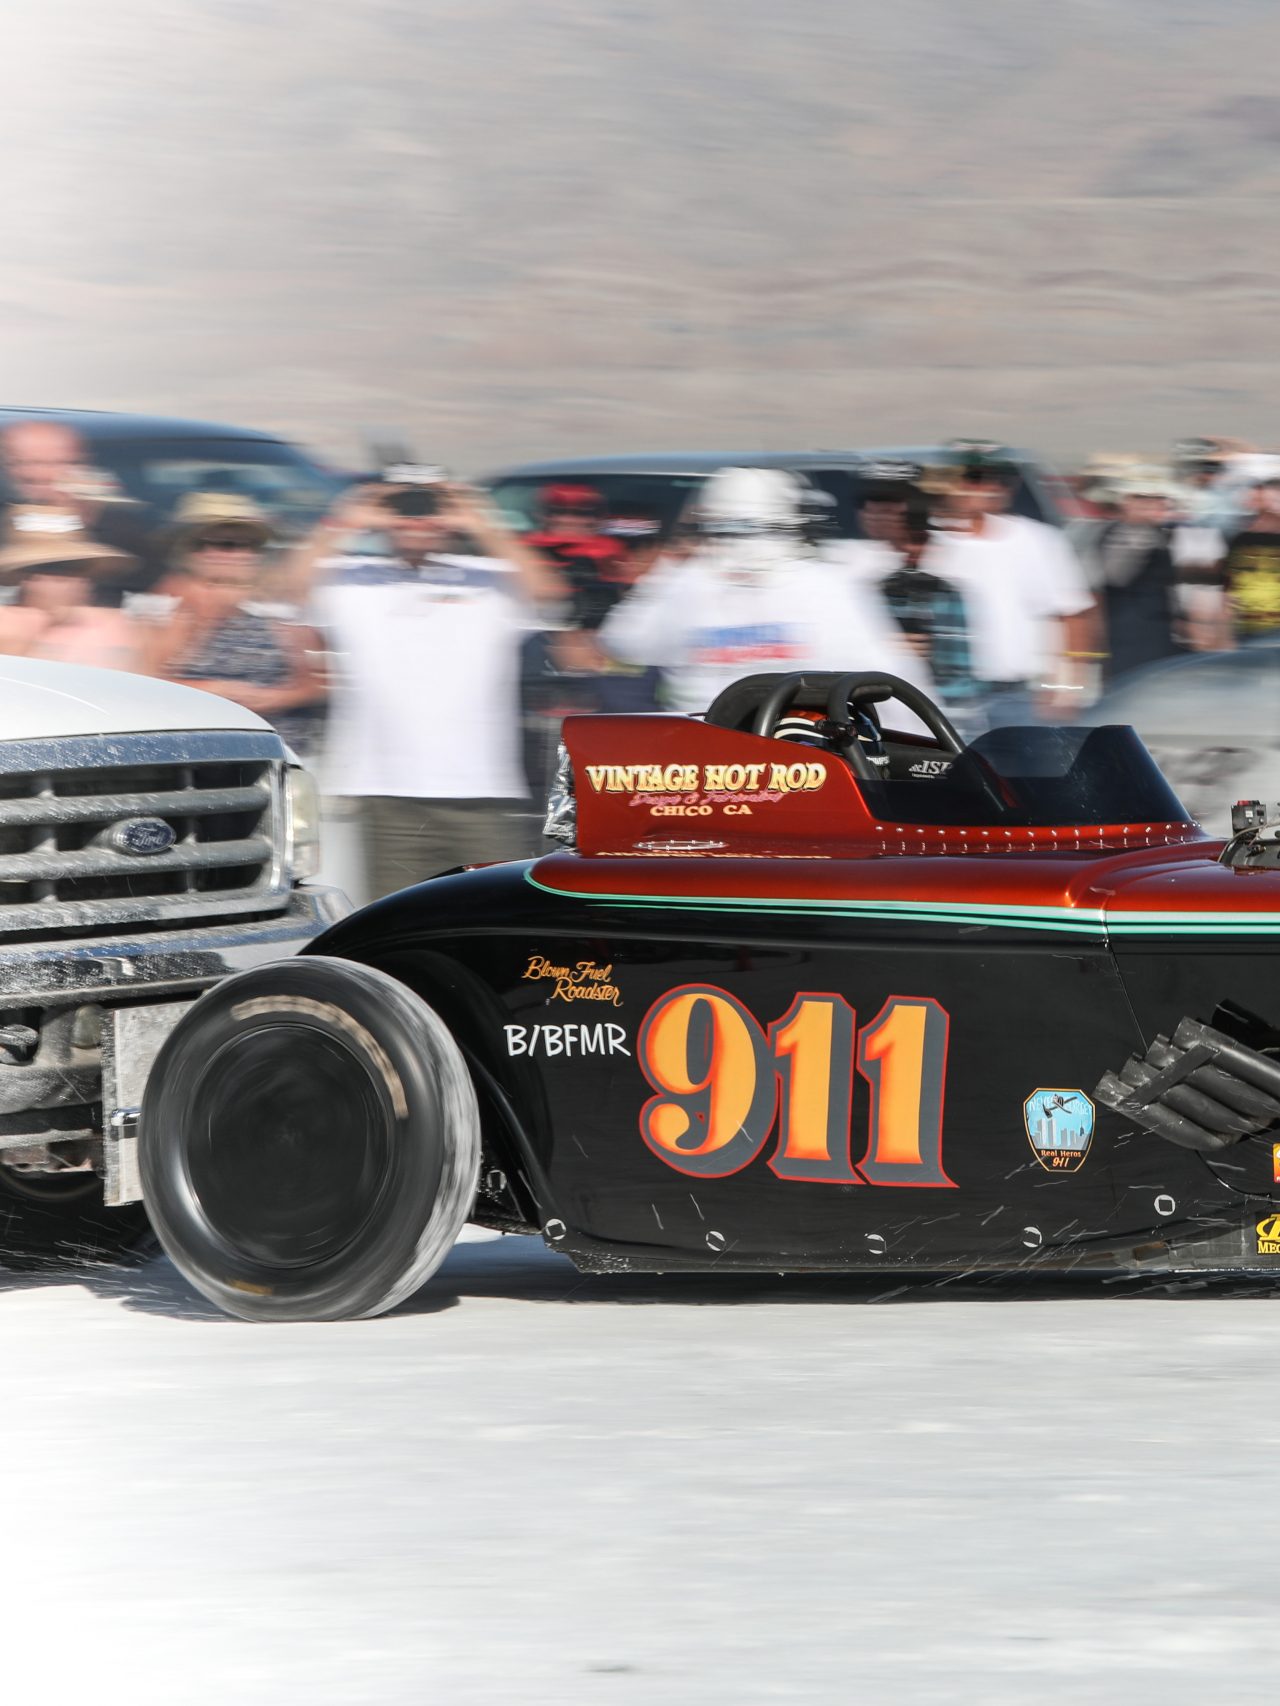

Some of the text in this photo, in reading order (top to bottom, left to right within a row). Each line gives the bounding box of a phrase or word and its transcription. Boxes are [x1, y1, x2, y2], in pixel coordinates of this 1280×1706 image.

[585, 762, 827, 793] VINTAGE HOT ROD
[650, 804, 752, 817] CHICO CA
[521, 955, 612, 983] Blown Fuel
[550, 976, 624, 1008] Roadster
[503, 1023, 632, 1057] B/BFMR
[636, 983, 960, 1188] 911
